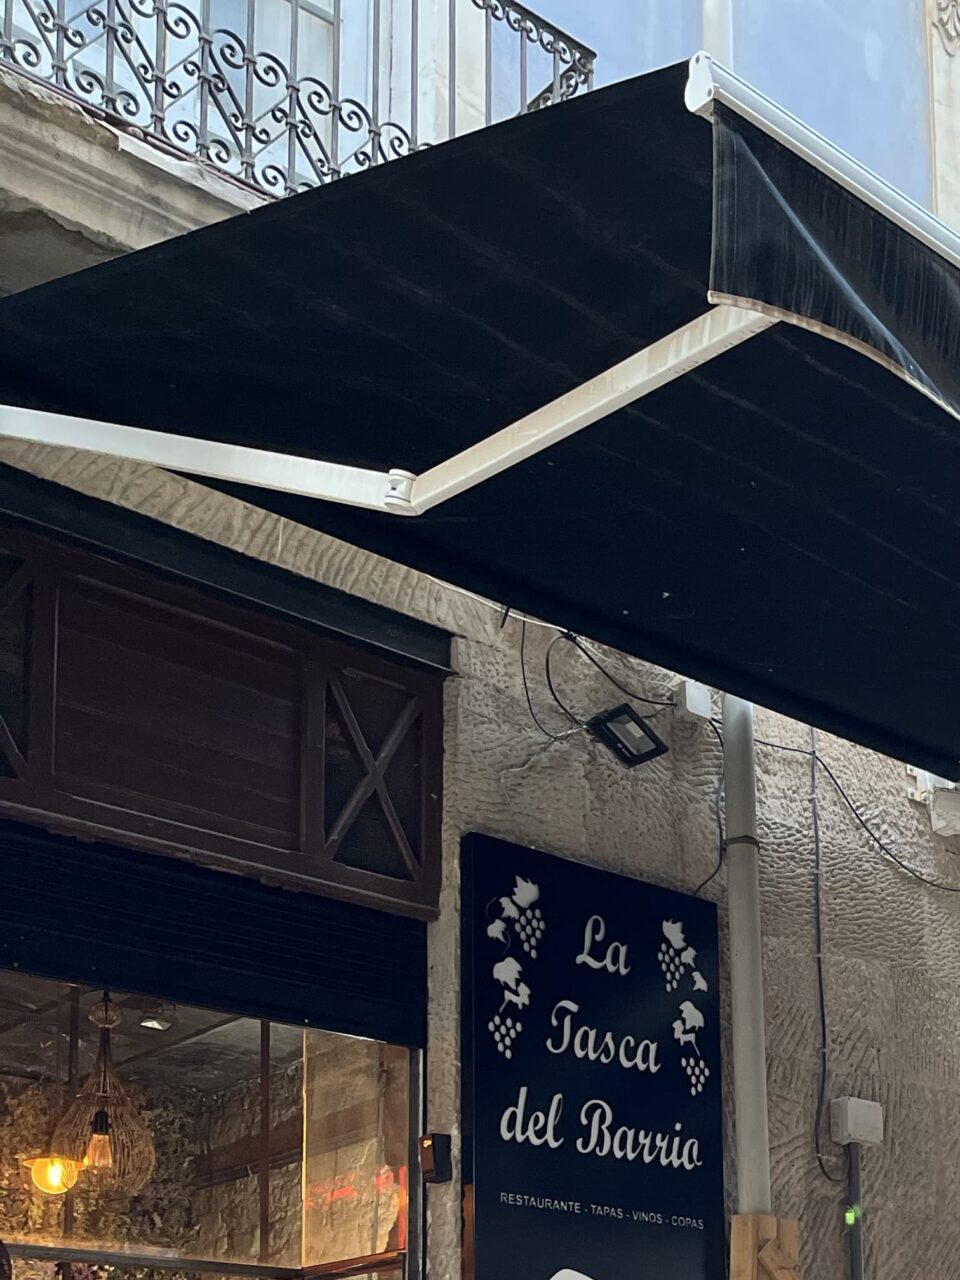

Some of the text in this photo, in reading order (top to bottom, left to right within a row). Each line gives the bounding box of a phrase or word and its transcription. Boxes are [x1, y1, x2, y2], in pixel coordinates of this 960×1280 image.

[576, 915, 632, 976] La
[545, 1000, 661, 1073] Tasca
[500, 1086, 703, 1170] del Barrio
[500, 1192, 704, 1230] RESTAURANTE TAPAS VINOS COPAS
